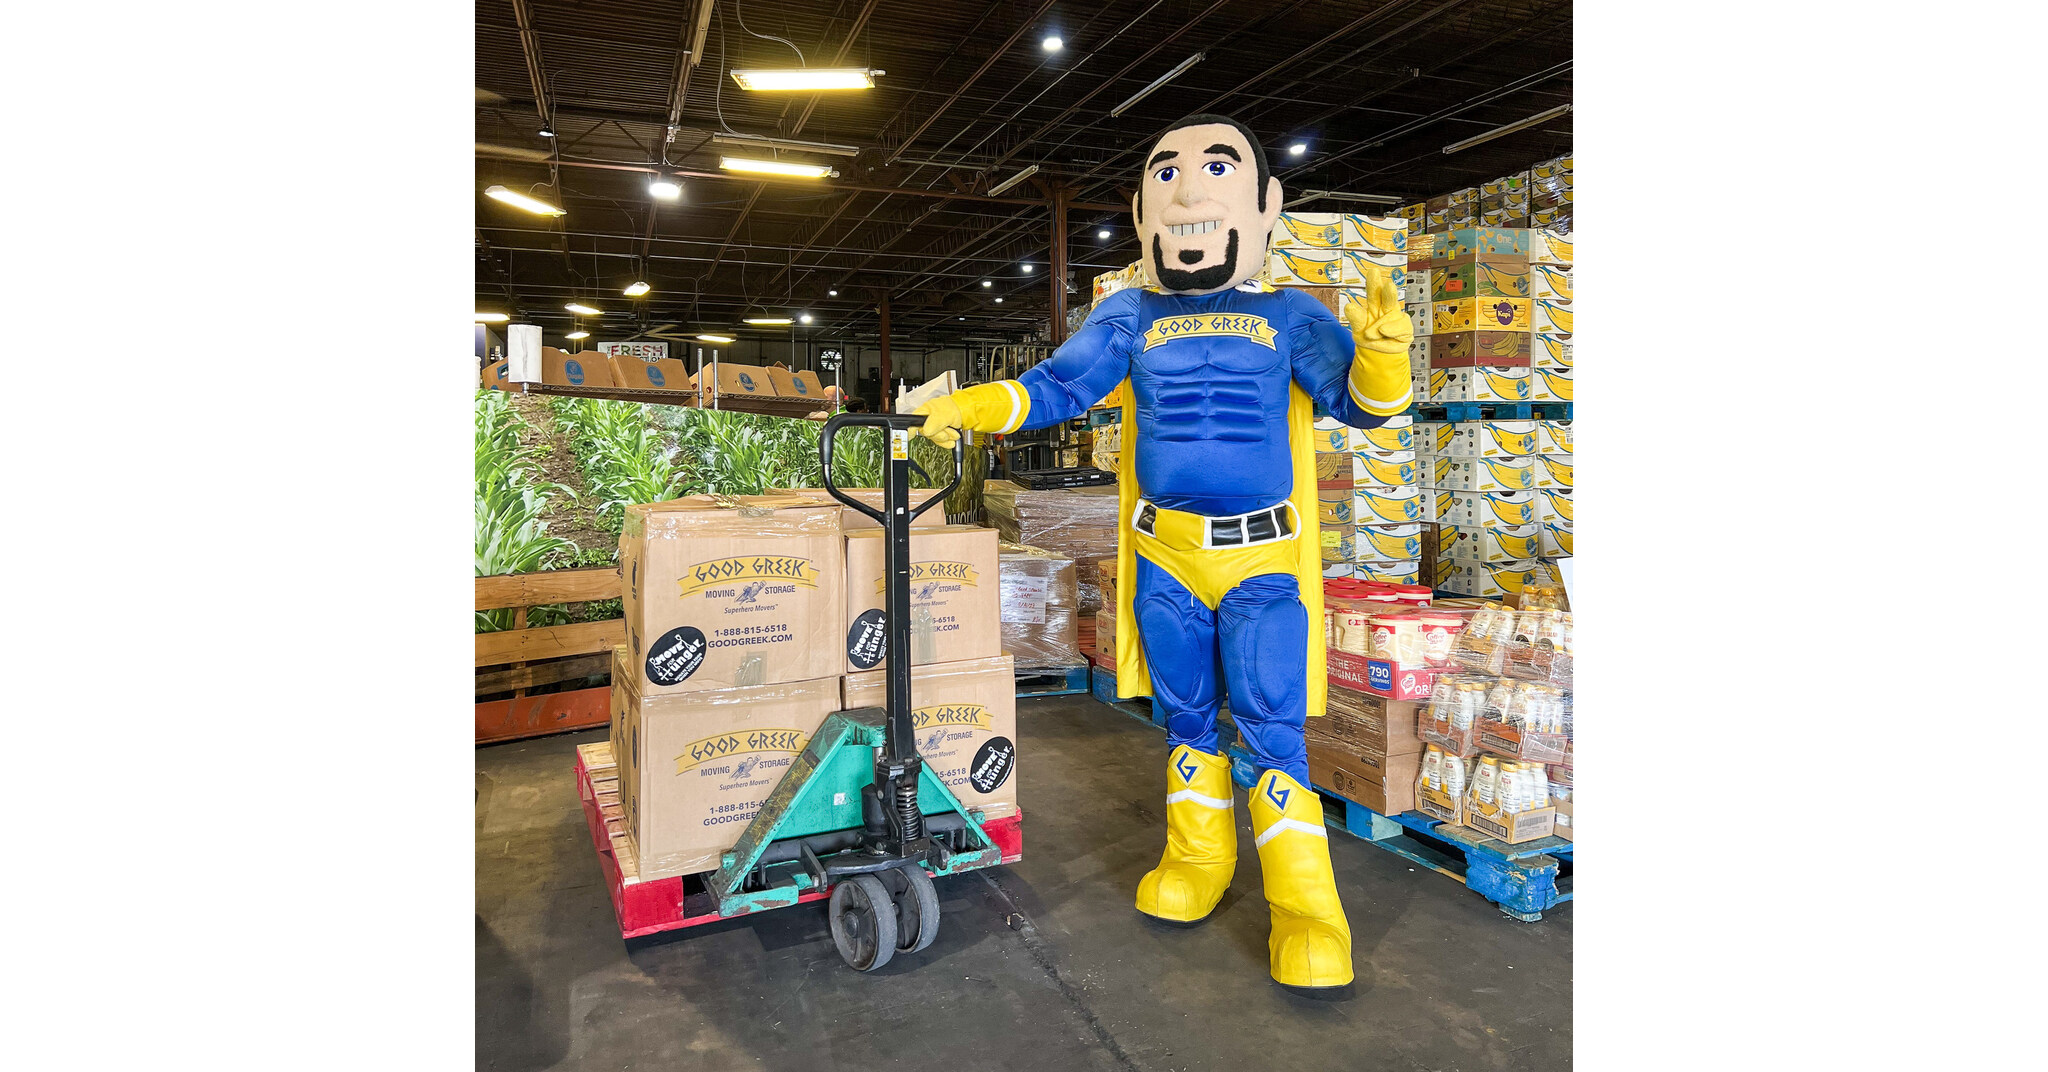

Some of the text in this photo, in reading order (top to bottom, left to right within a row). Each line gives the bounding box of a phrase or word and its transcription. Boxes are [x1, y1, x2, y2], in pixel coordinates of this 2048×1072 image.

[1158, 316, 1262, 336] GOOD GREEK
[611, 345, 663, 356] FRESH
[695, 558, 805, 582] GOOD GREEK
[930, 563, 968, 578] GREEK
[705, 585, 796, 599] MOVING STORAGE
[939, 585, 961, 593] STORAGE
[724, 605, 754, 614] Superhero
[714, 624, 787, 637] 1-888-815-6518
[708, 634, 793, 648] GOODGREEK.COM
[854, 625, 873, 653] MOVE
[655, 640, 685, 665] MOVE
[1370, 666, 1389, 678] 790
[1415, 684, 1432, 694] ORI
[936, 707, 981, 723] GREEK
[946, 731, 973, 741] STORAGE
[691, 731, 800, 761] GOOD GREEK
[701, 758, 790, 777] MOVING STORAGE
[976, 751, 998, 779] MOVE
[1176, 751, 1198, 783] G
[719, 782, 749, 791] Superhero
[1266, 775, 1290, 810] G
[710, 799, 767, 814] 1-888-815-6
[703, 811, 759, 826] GOODGREE
